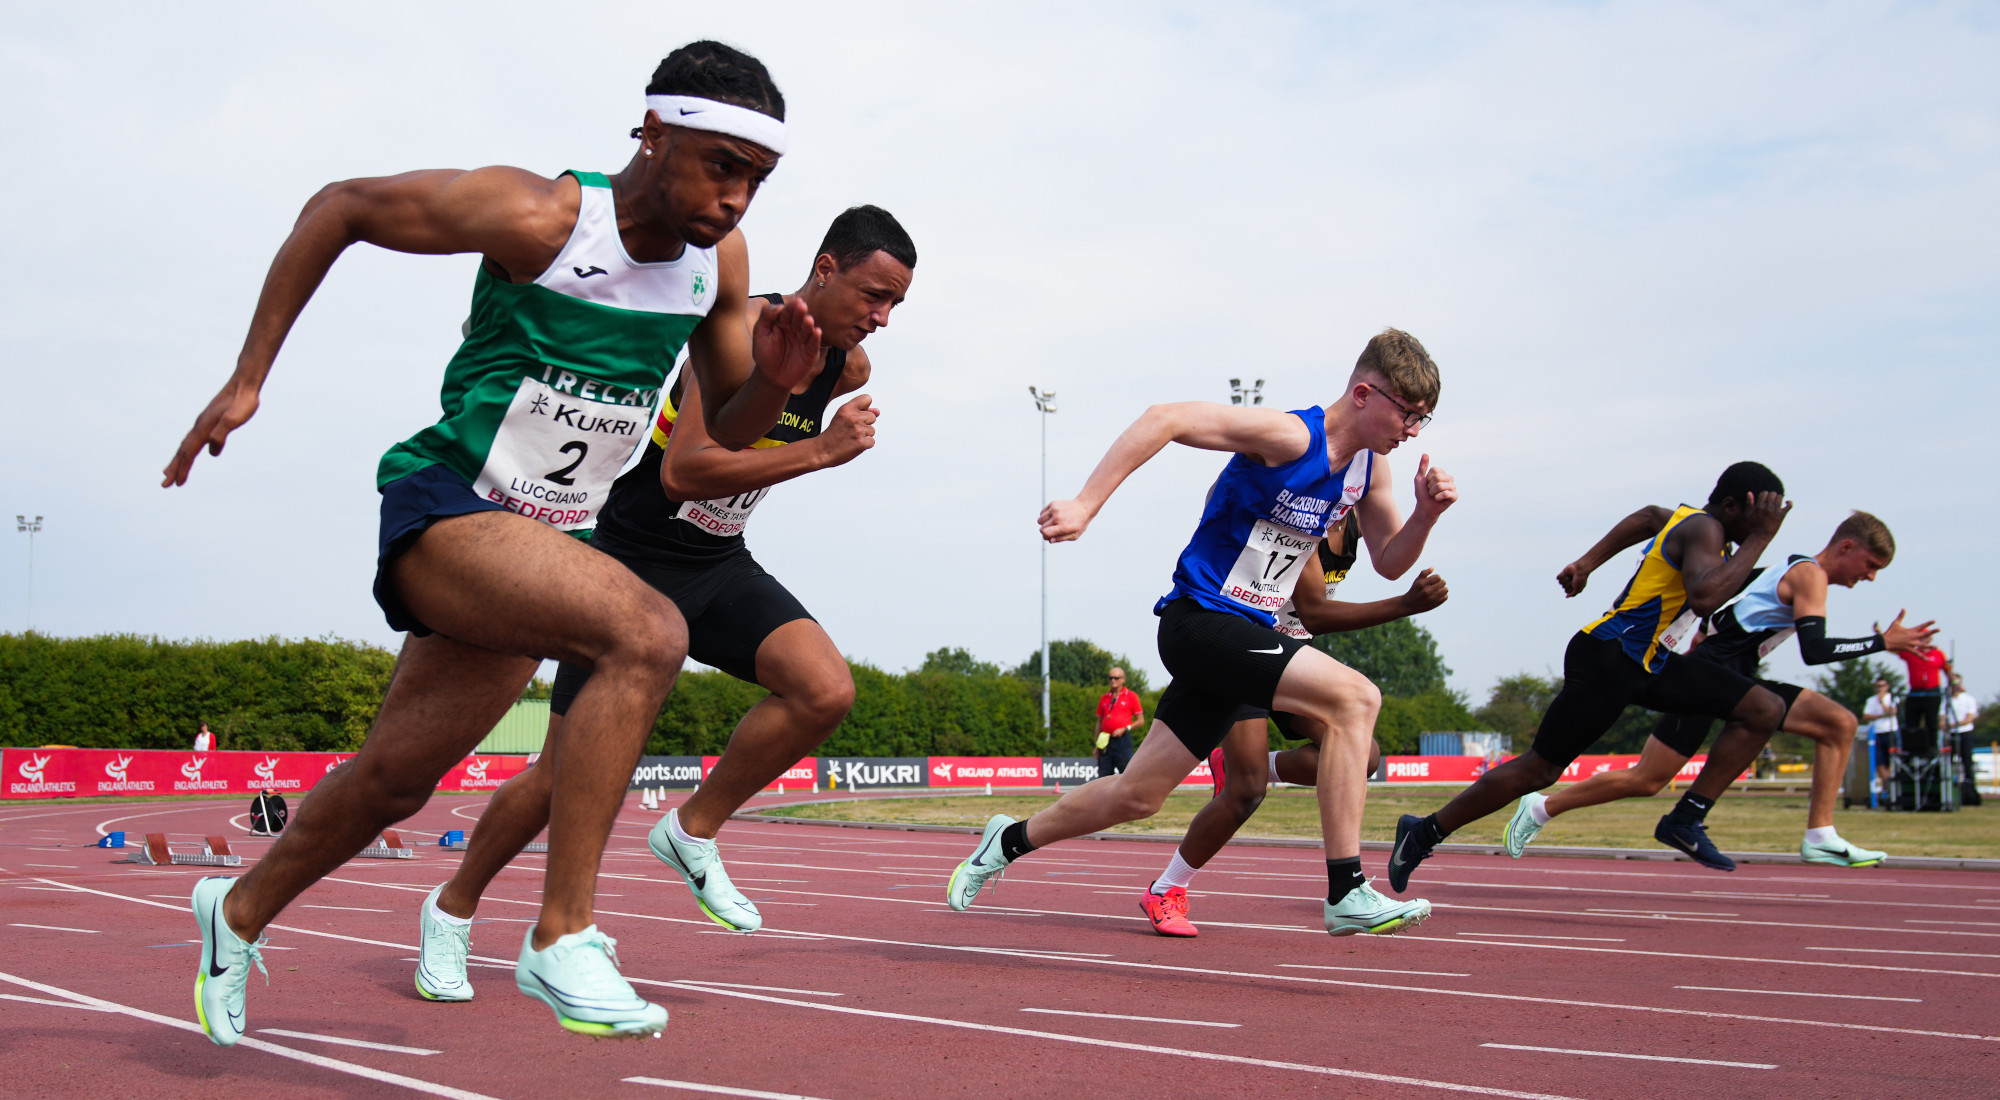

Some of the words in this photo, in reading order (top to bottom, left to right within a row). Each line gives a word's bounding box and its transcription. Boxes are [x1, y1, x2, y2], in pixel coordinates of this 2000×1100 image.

[553, 404, 636, 436] KUKRI
[777, 412, 800, 428] TON
[799, 418, 814, 432] AC
[544, 440, 589, 486] 2
[511, 477, 588, 504] LUCCIANO
[487, 487, 589, 525] BEDFORD
[1276, 489, 1331, 514] BLACKBURN
[1270, 504, 1321, 529] HARRIERS
[1274, 533, 1314, 550] KUKRI
[1263, 550, 1298, 580] 17
[1250, 581, 1280, 593] NUTTALL
[1230, 585, 1286, 608] BEDFORD
[1273, 624, 1310, 637] EDFORD
[845, 762, 921, 784] KUKRI
[957, 767, 994, 777] ENGLAND
[996, 767, 1038, 777] ATHLETICS
[1387, 762, 1430, 777] PRIDE
[11, 782, 41, 793] ENGLAND
[43, 781, 76, 792] ATHLETICS
[97, 781, 124, 791] ENGLAND
[126, 780, 155, 791] ATHLETICS
[174, 780, 199, 790] ENGLAND
[201, 779, 228, 790] ATHLETICS
[247, 779, 271, 789] ENGLAND
[273, 779, 301, 789] ATHLETICS
[460, 778, 485, 787] ENGLAND
[106, 837, 112, 847] 2
[444, 835, 449, 846] 1
